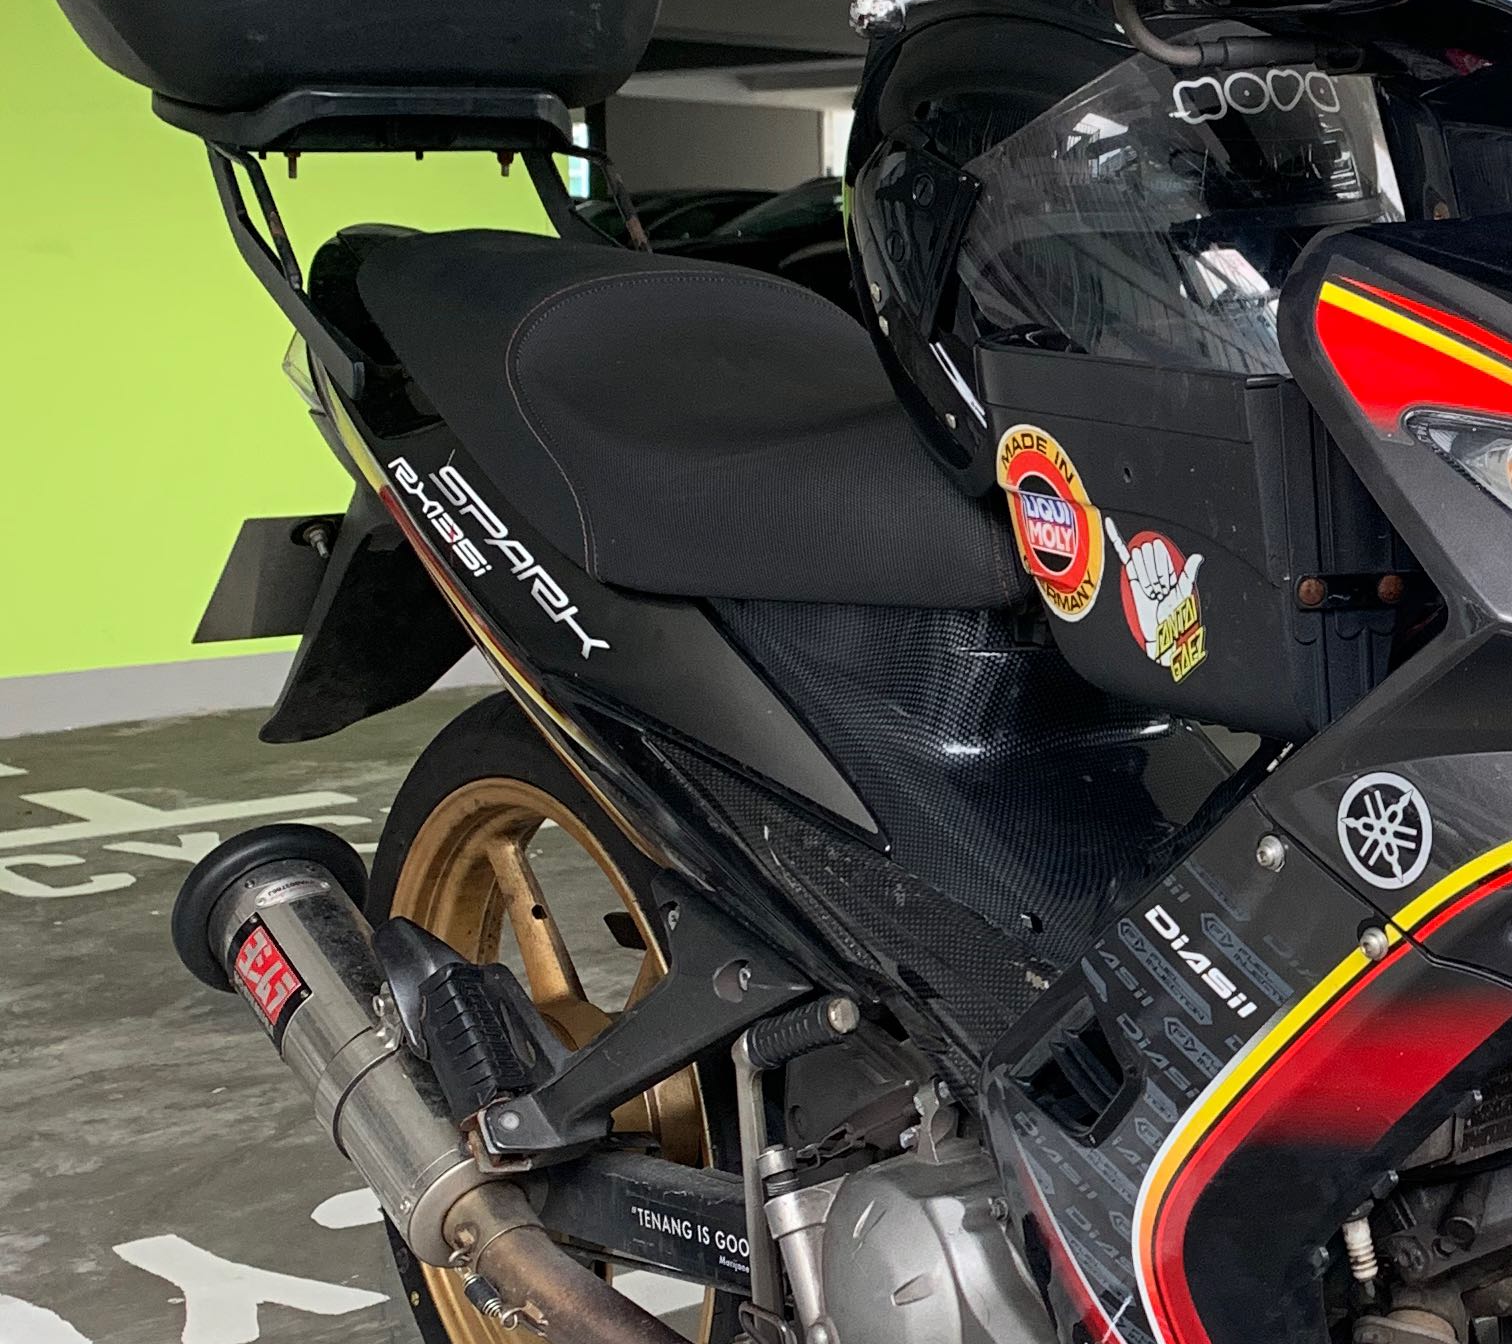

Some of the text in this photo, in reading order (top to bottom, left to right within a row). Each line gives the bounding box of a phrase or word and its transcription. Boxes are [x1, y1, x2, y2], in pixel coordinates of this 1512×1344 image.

[1001, 433, 1074, 485] MADE IN
[1022, 494, 1072, 526] LIQUI
[1028, 521, 1073, 553] MOLY
[428, 464, 611, 660] SPARK
[697, 1224, 710, 1245] IS
[715, 1230, 750, 1258] GOO
